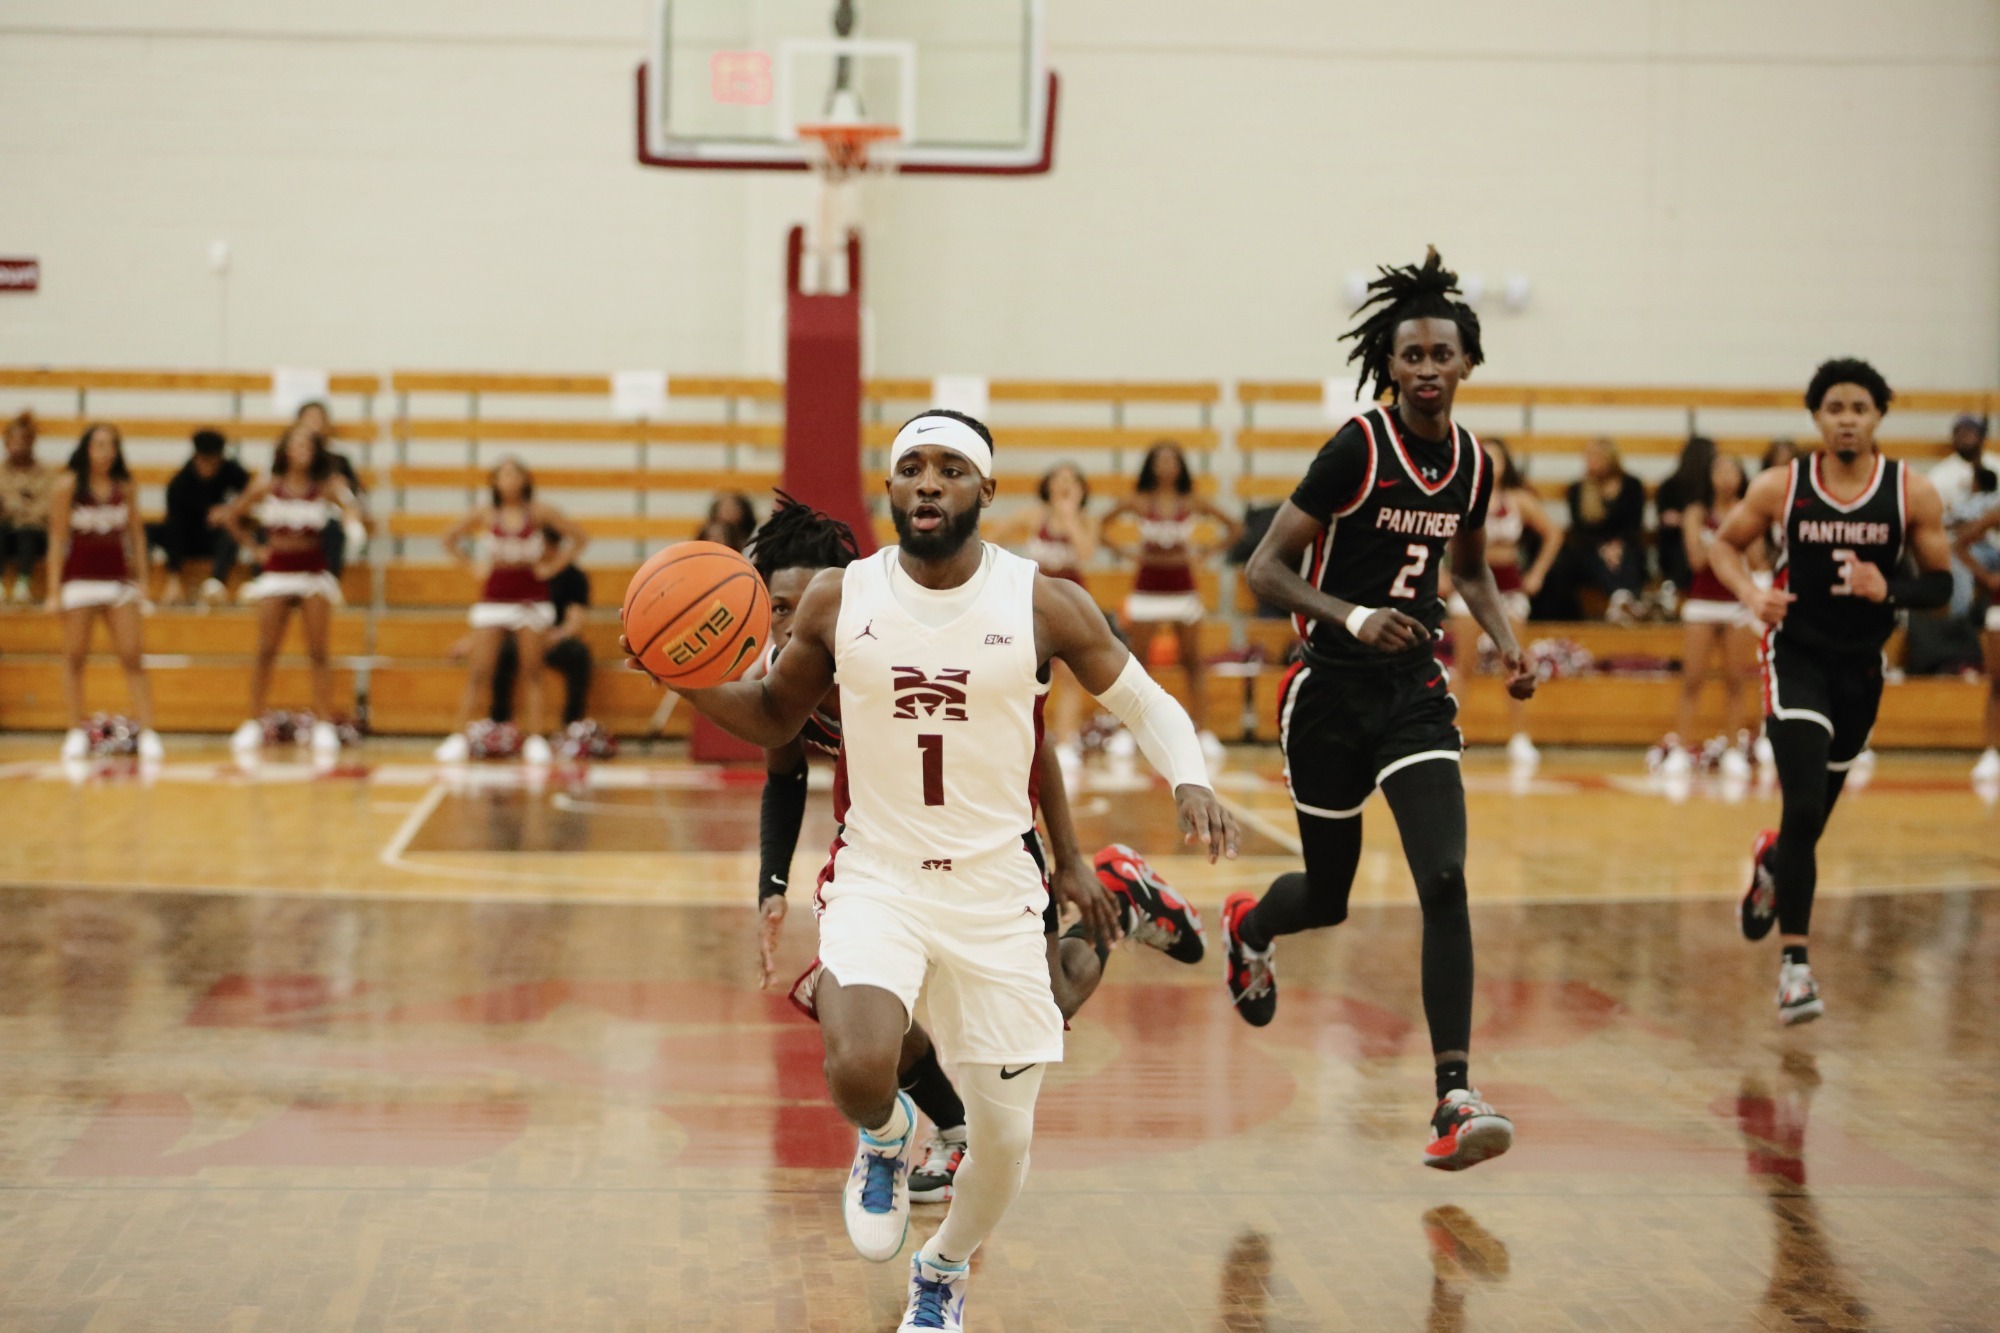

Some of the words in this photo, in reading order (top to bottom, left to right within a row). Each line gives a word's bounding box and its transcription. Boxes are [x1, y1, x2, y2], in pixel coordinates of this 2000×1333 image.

[1375, 506, 1461, 538] PANTHERS
[1798, 520, 1889, 545] PANTHERS
[1388, 542, 1429, 599] 2
[1829, 548, 1855, 595] 3
[664, 603, 735, 666] ELITE
[917, 733, 945, 806] 1
